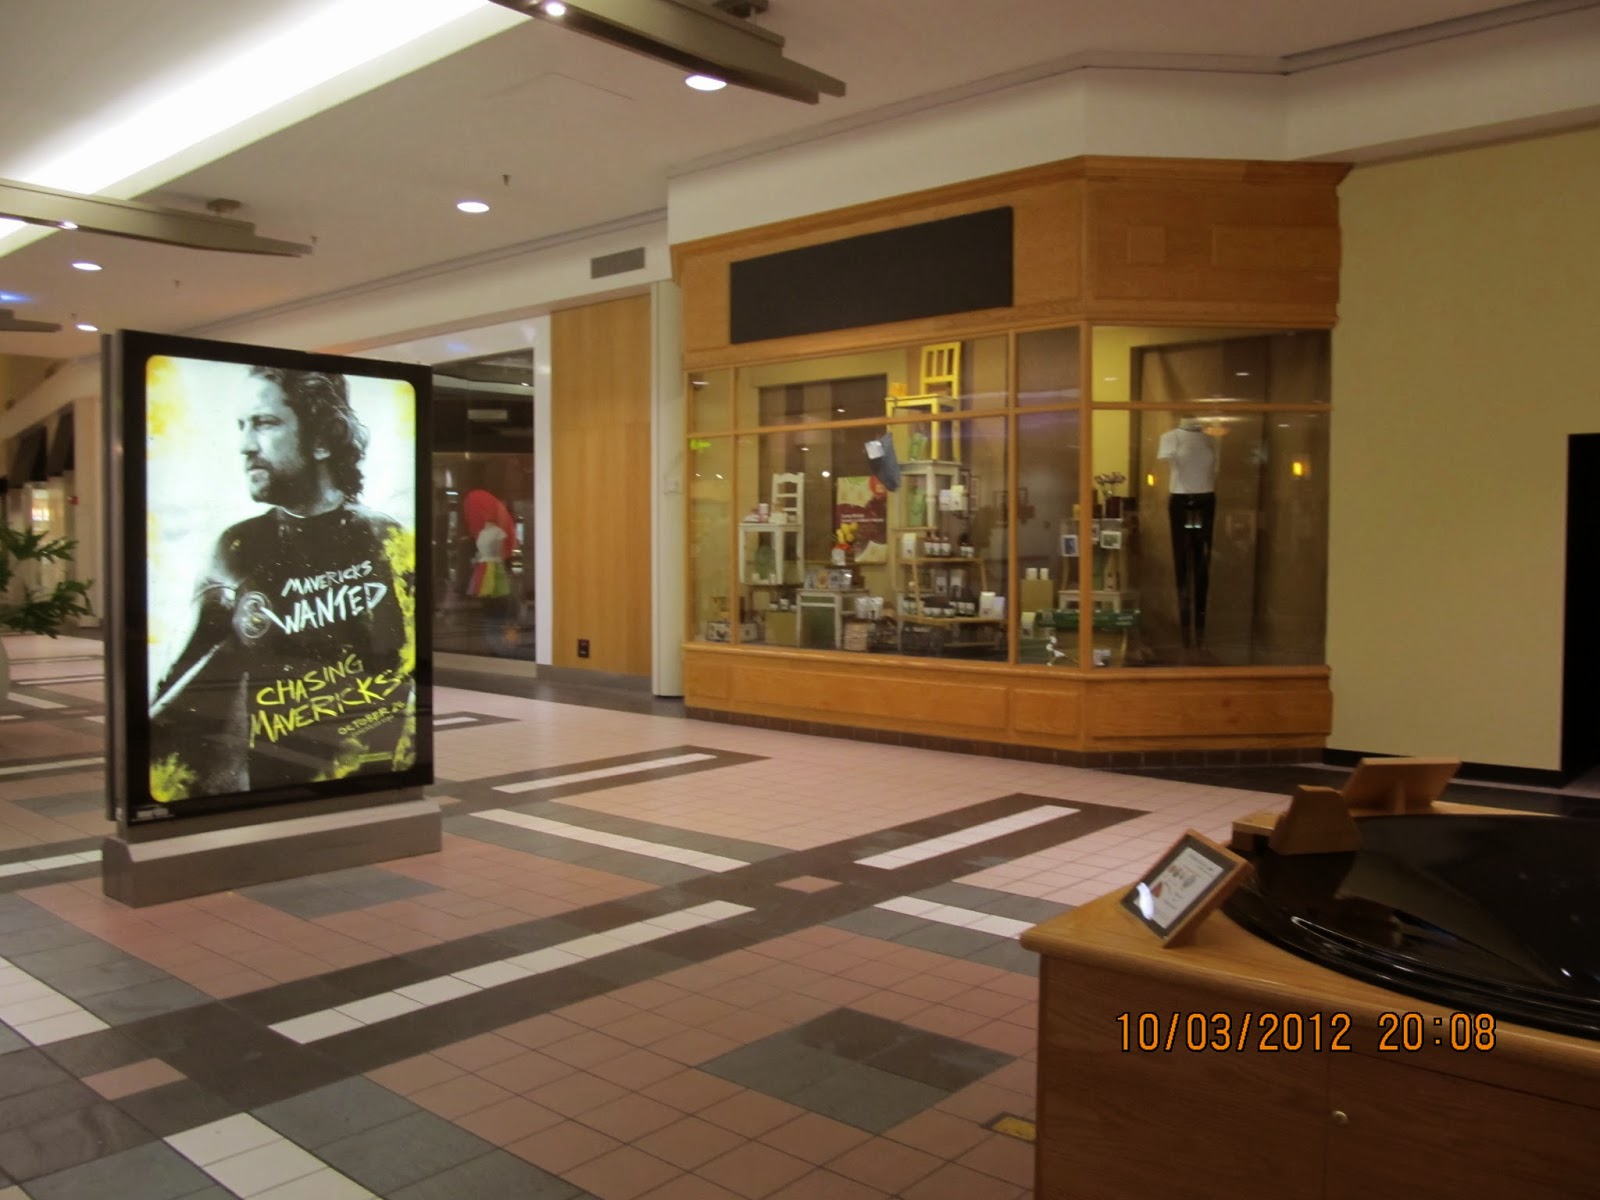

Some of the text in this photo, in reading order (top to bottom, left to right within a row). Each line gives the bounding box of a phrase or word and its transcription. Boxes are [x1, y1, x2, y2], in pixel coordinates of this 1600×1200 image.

[281, 560, 373, 597] MAVERICKS
[260, 582, 388, 635] WANTED
[256, 653, 364, 706] CHASING
[249, 668, 402, 749] MAVERICKS
[337, 707, 391, 736] OCTOBER
